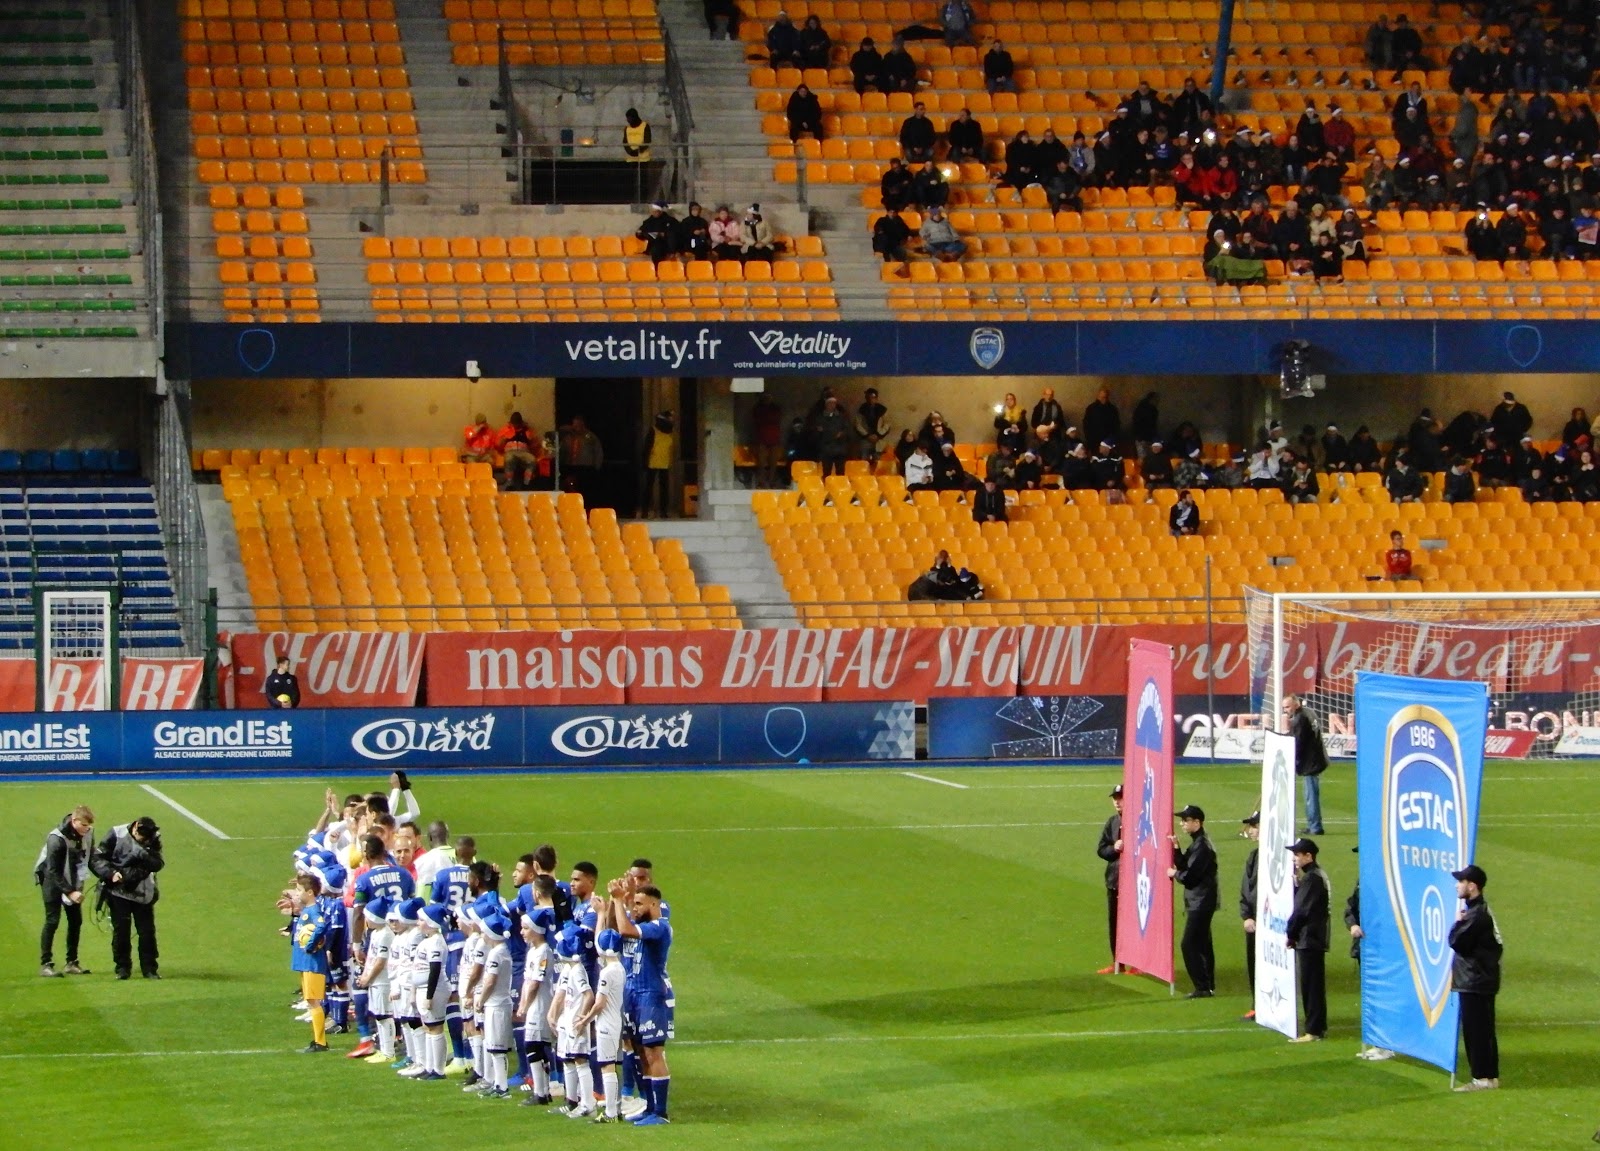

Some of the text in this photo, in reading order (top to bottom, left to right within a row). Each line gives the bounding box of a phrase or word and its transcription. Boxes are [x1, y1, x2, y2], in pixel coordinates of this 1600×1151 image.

[564, 328, 722, 369] vetality.fr
[748, 330, 852, 359] Vetality
[733, 361, 754, 369] votre
[755, 360, 797, 369] animalerie
[797, 360, 833, 370] premium
[846, 360, 867, 370] ligne
[466, 630, 704, 690] maisons
[1409, 725, 1436, 750] 1986
[57, 753, 91, 761] LORRAINE
[154, 750, 293, 759] ALSACE CHAMPAGNE-ARDENNE LORRAINE
[1398, 791, 1454, 838] ESTAC
[1401, 844, 1456, 873] TROYES
[369, 871, 401, 887] FORTUNE
[1425, 905, 1441, 944] 10
